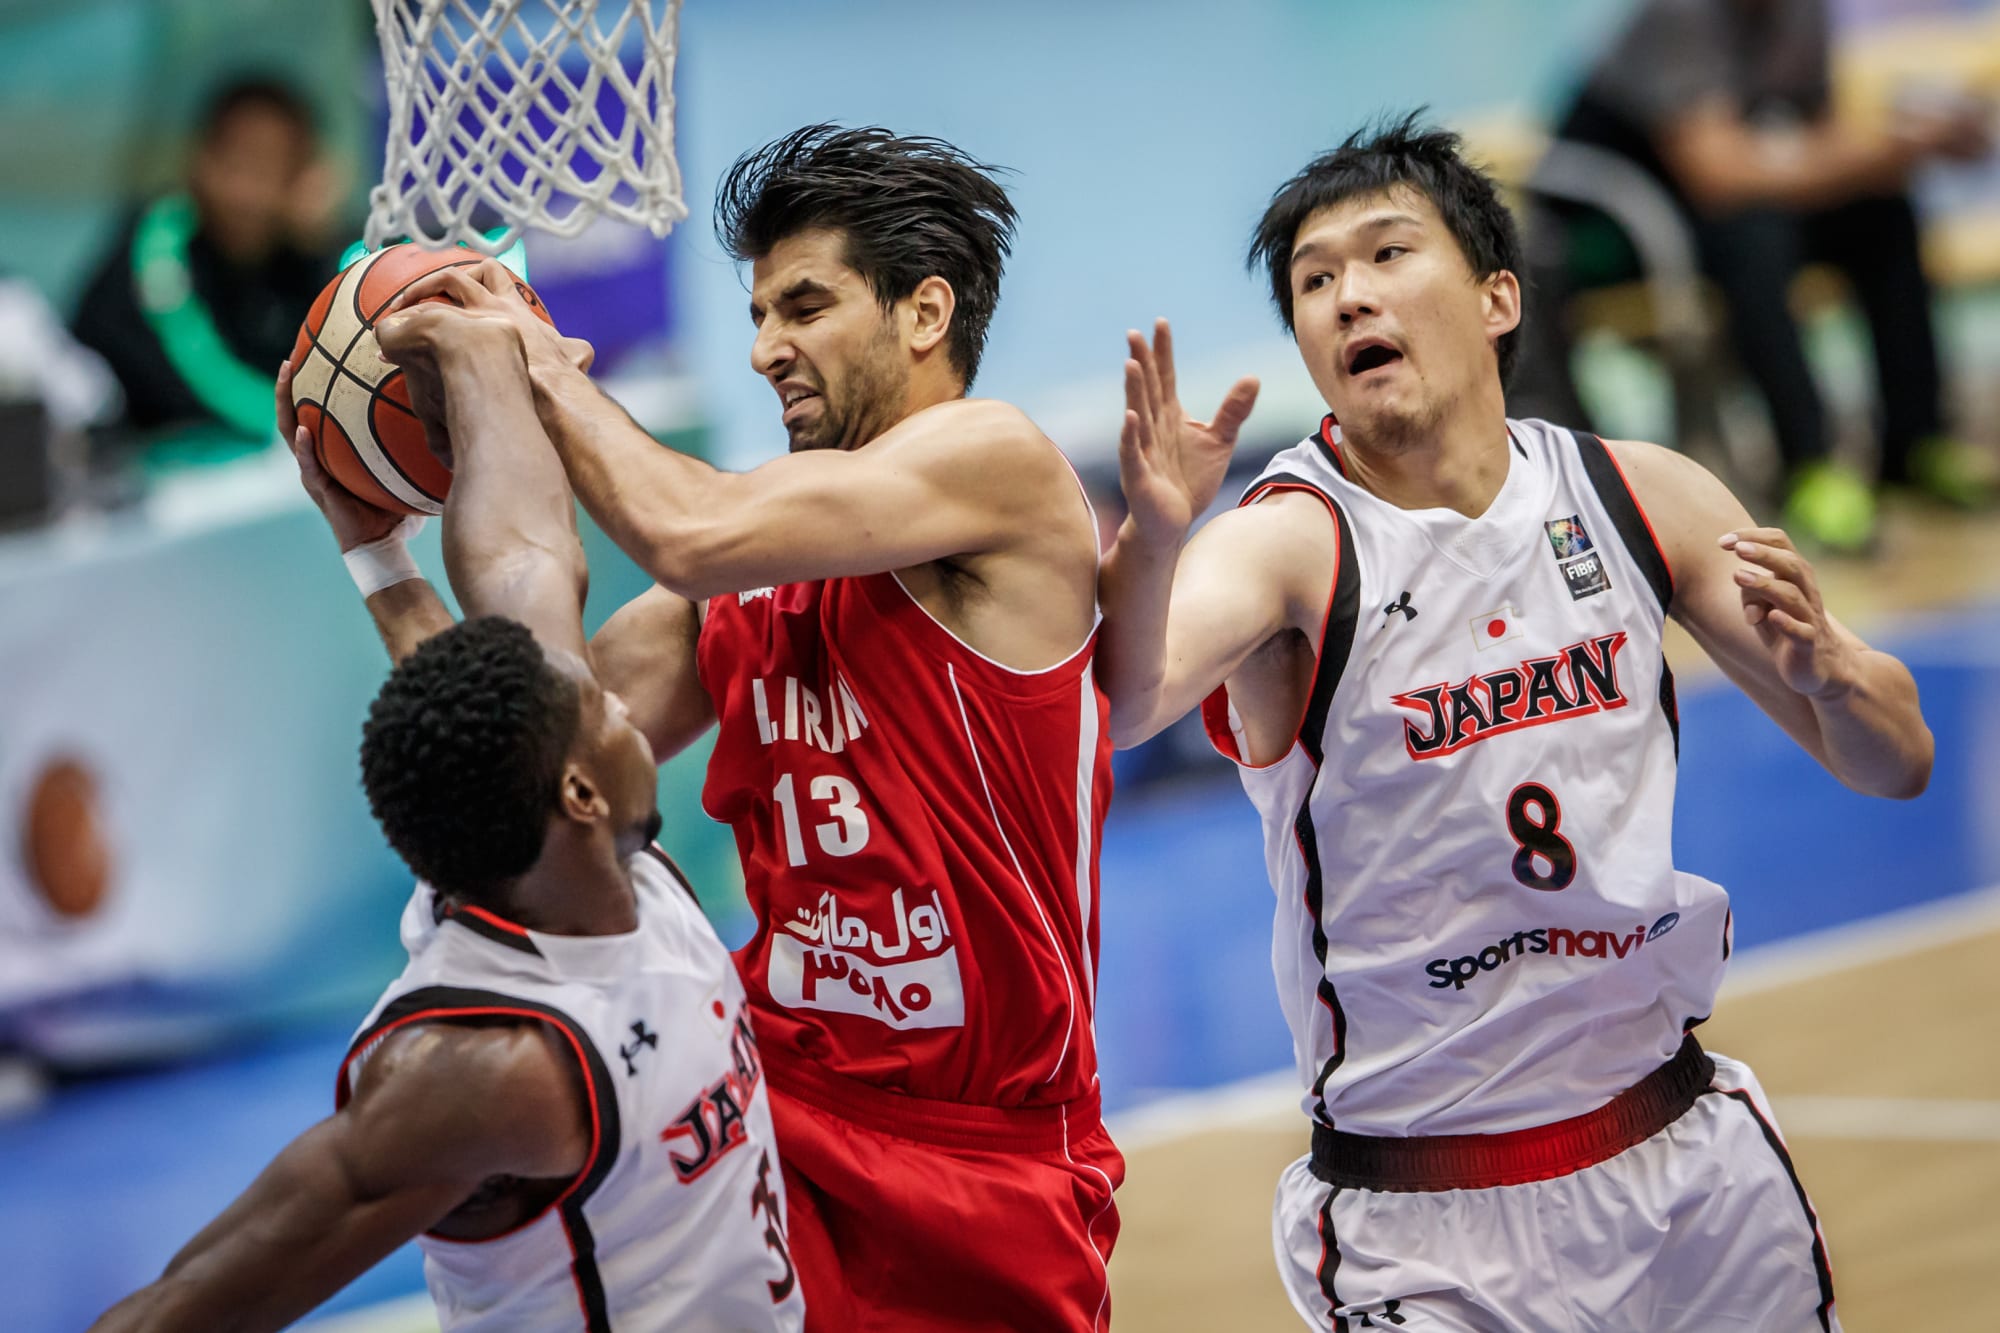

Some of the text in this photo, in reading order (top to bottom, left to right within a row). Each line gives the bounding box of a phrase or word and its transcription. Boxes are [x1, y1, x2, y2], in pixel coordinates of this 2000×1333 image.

[1566, 560, 1598, 581] FIBA
[1391, 631, 1629, 761] JAPAN
[773, 773, 870, 867] 13
[1506, 781, 1577, 892] 8
[870, 887, 951, 959] اول
[1425, 925, 1646, 991] sportsnavi
